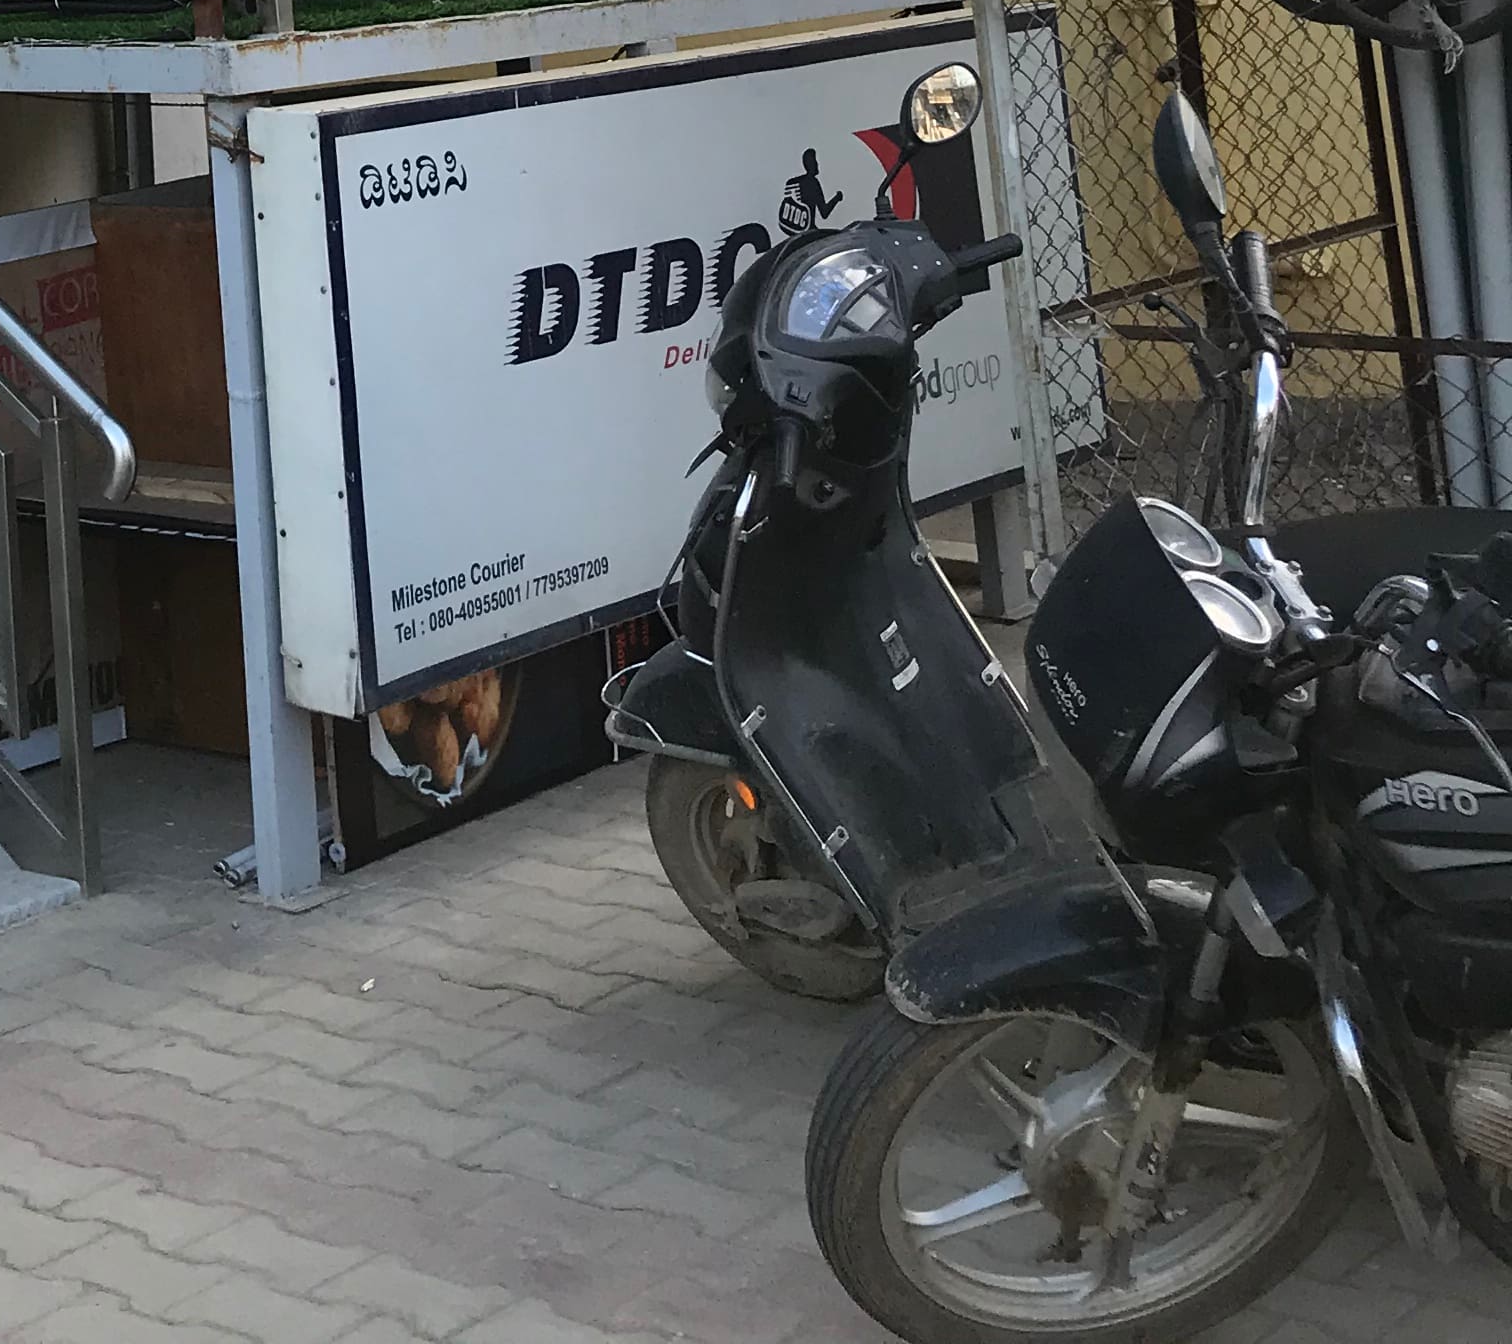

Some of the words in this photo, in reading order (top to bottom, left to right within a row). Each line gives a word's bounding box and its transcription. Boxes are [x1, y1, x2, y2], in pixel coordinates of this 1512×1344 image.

[782, 202, 807, 228] DTDC
[391, 566, 467, 612] Milestone
[470, 551, 526, 592] Courier
[394, 622, 417, 645] Tel
[428, 586, 522, 633] 080-40955001
[533, 555, 610, 596] 7795397209
